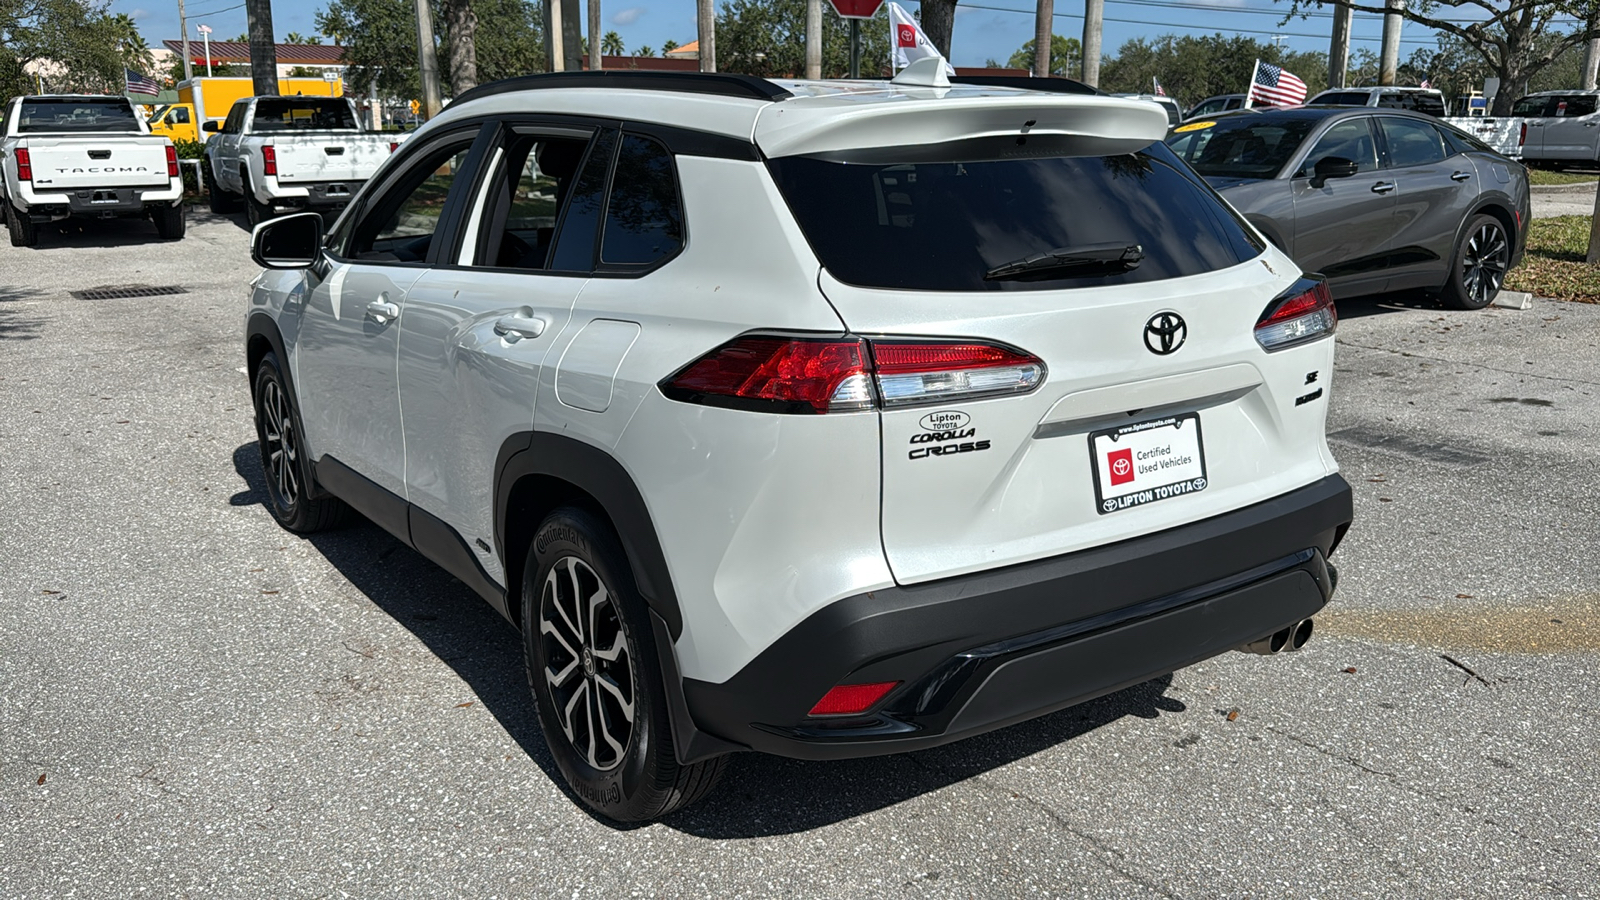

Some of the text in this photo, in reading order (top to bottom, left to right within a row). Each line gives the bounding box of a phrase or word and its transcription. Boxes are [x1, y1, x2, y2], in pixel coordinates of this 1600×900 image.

[55, 166, 148, 174] TACOMA
[930, 414, 961, 424] Lipton
[933, 422, 958, 430] TOYOTA
[909, 427, 976, 444] COROLLA
[908, 439, 991, 460] CROSS
[1136, 444, 1171, 461] Certified
[1138, 455, 1192, 474] Used Vehicles
[1117, 481, 1194, 509] LIPTON TOYOTA
[536, 524, 581, 554] Continental
